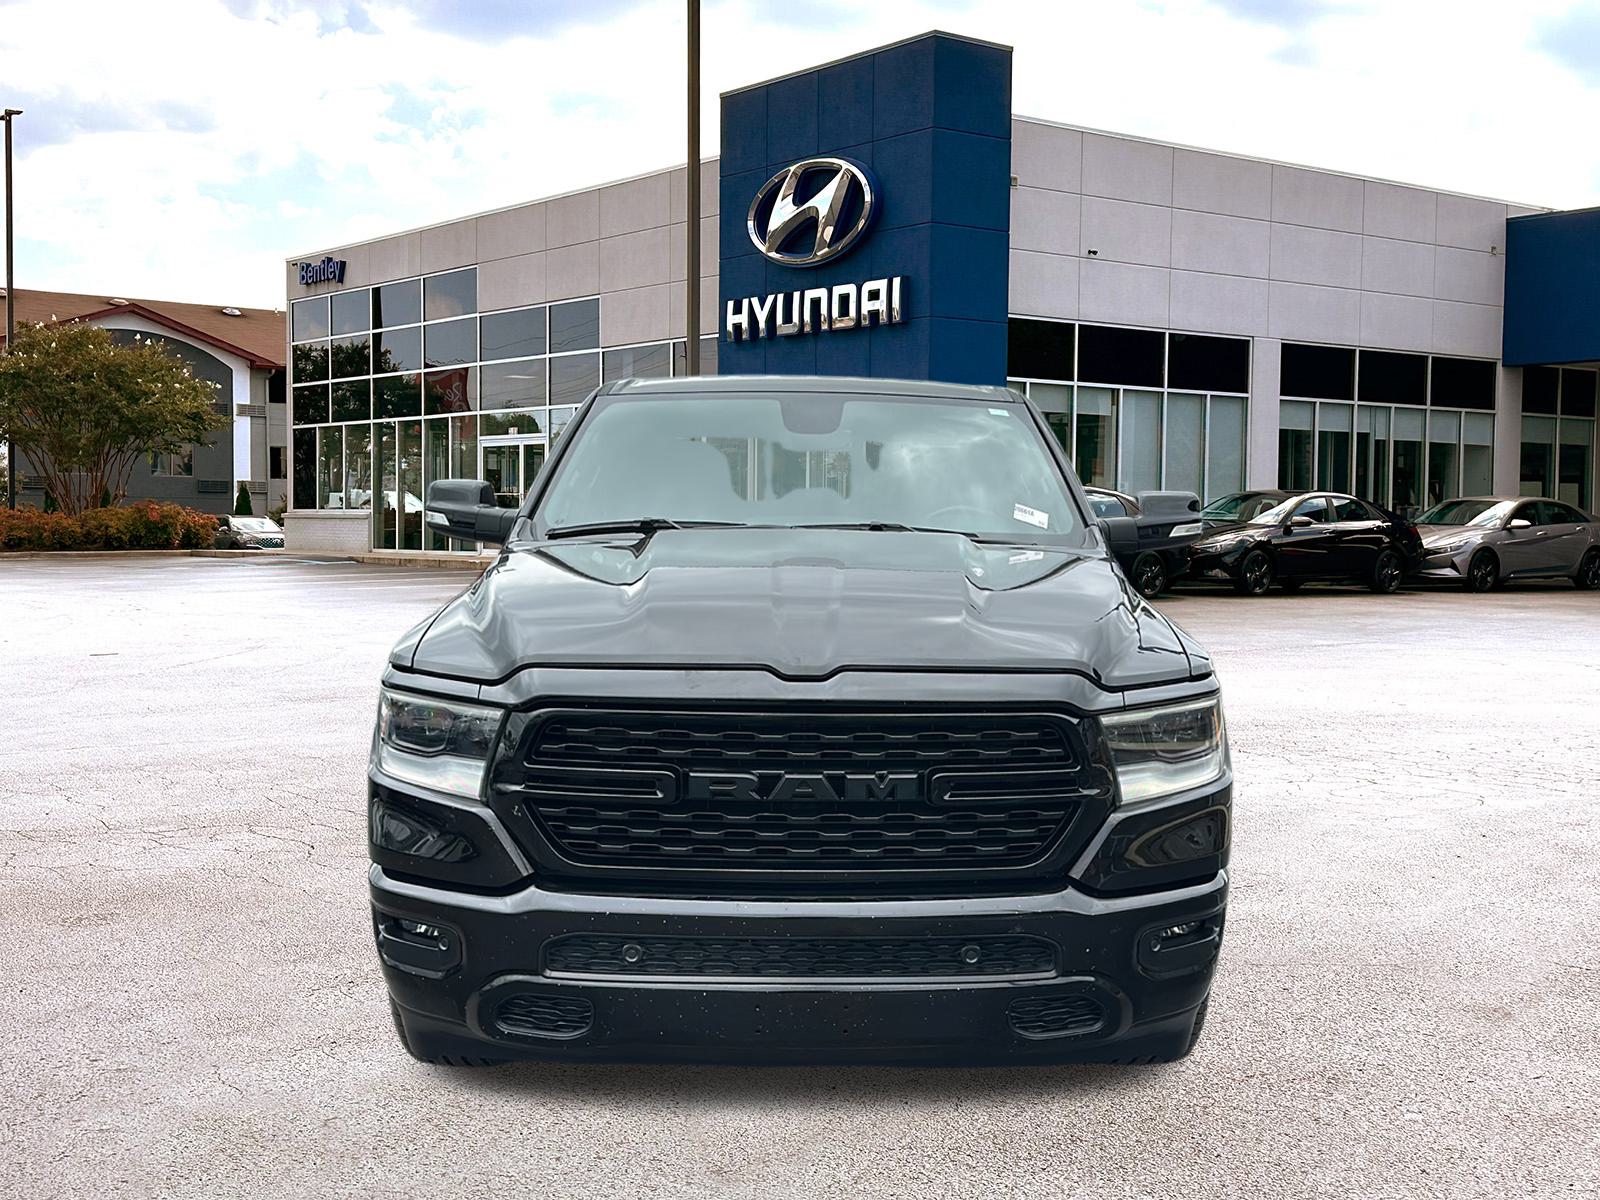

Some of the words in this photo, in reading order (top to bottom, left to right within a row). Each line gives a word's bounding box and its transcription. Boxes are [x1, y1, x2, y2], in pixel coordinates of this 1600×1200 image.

[299, 256, 346, 285] Bentley
[726, 276, 907, 342] HYUNDAI
[689, 772, 918, 801] RAM
